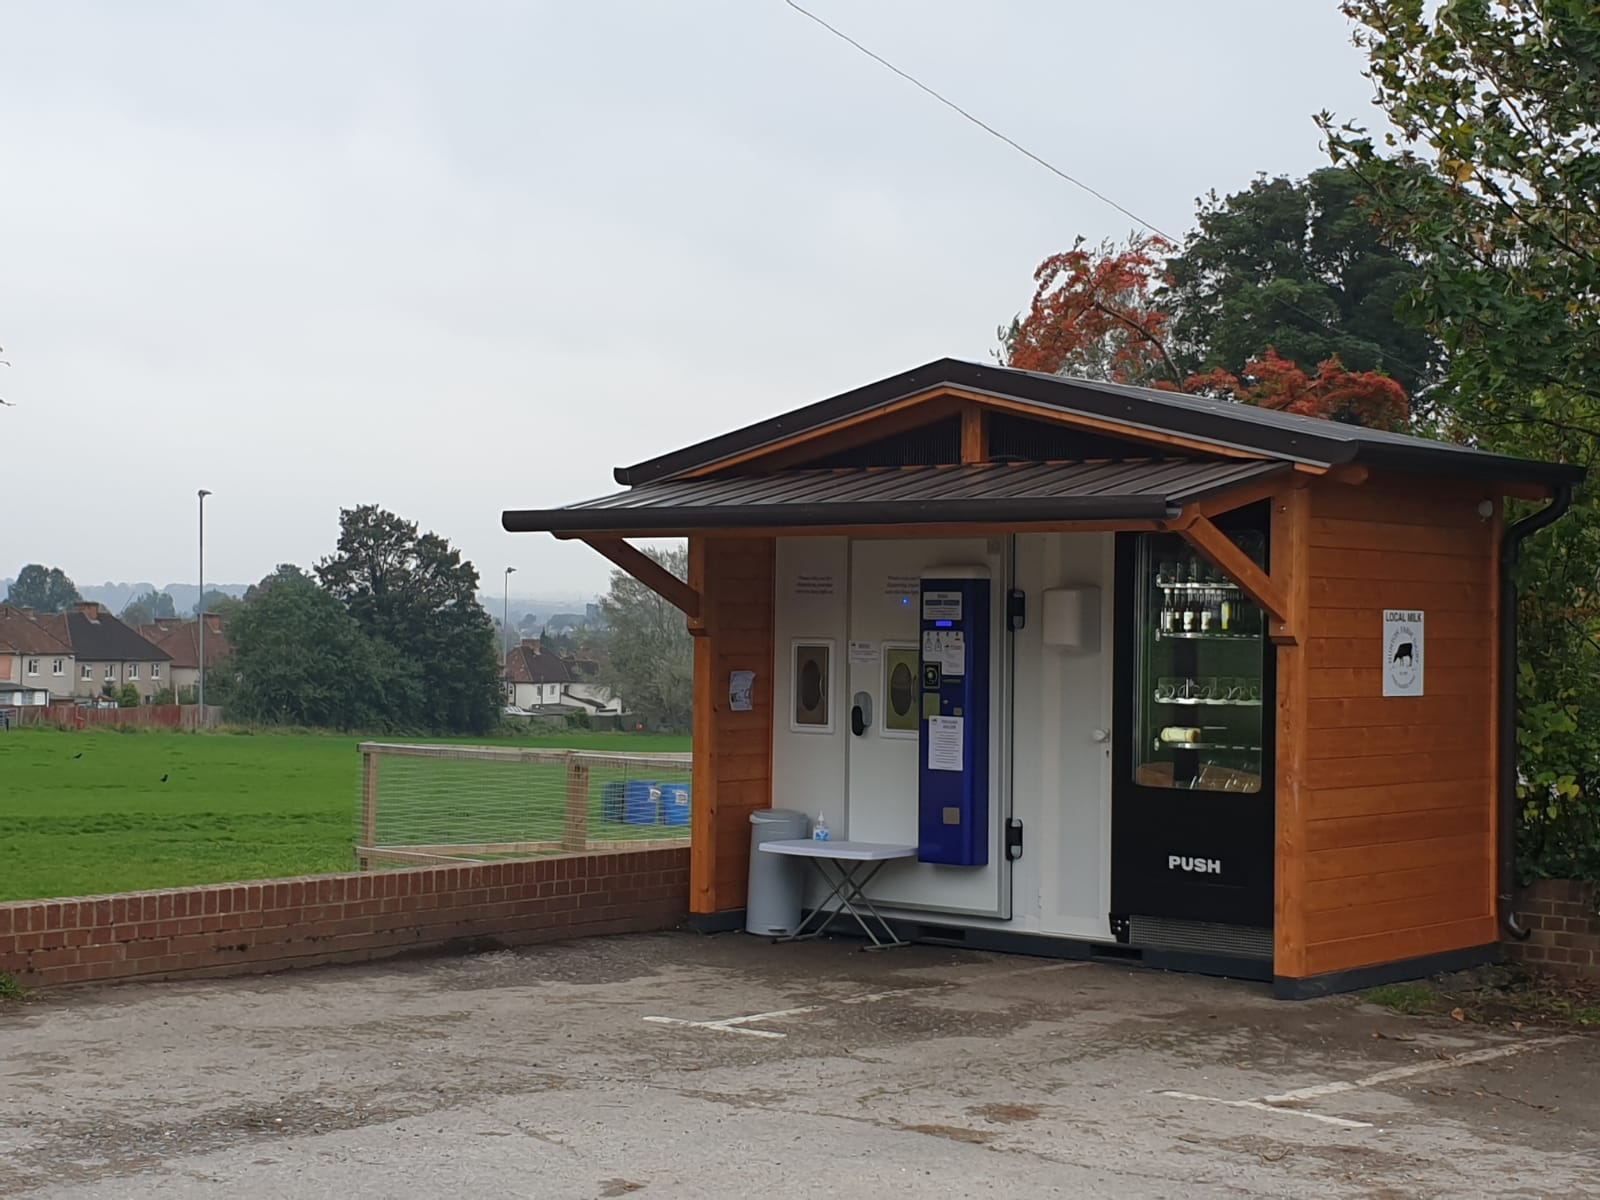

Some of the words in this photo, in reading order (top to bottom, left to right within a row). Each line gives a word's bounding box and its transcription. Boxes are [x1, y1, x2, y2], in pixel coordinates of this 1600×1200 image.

[1385, 611, 1406, 622] LOCAL
[1407, 612, 1422, 623] MILK
[1168, 855, 1221, 874] PUSH
